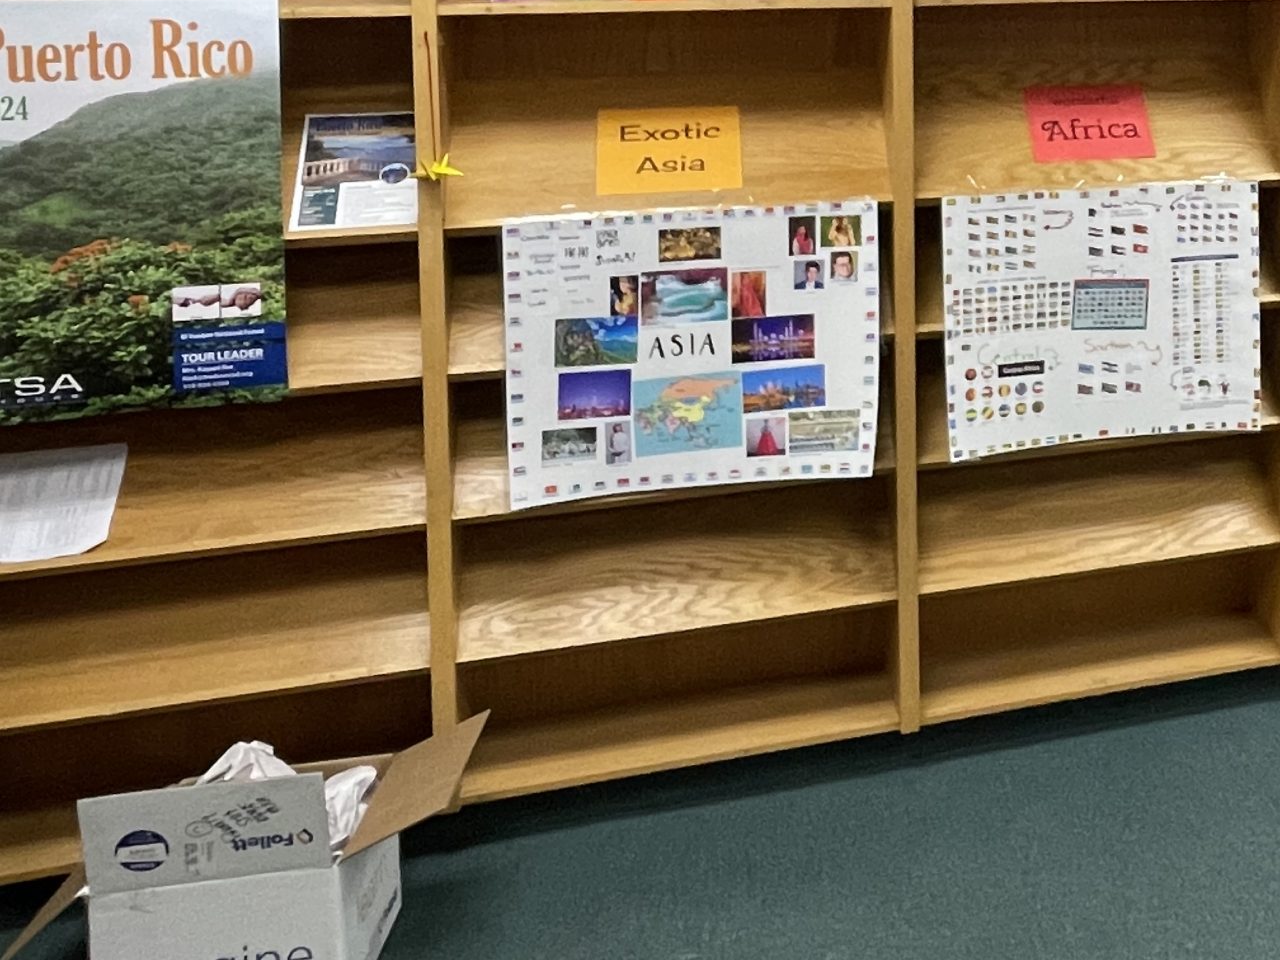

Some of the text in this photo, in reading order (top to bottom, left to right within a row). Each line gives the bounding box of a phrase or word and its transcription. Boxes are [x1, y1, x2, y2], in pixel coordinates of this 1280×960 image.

[0, 18, 254, 83] uerto Rico
[620, 122, 721, 142] Exotic
[1041, 118, 1141, 142] Africa
[636, 155, 706, 174] Asia
[181, 348, 264, 364] TOUR LEADER
[648, 333, 715, 359] ASIA
[232, 832, 294, 852] Follett
